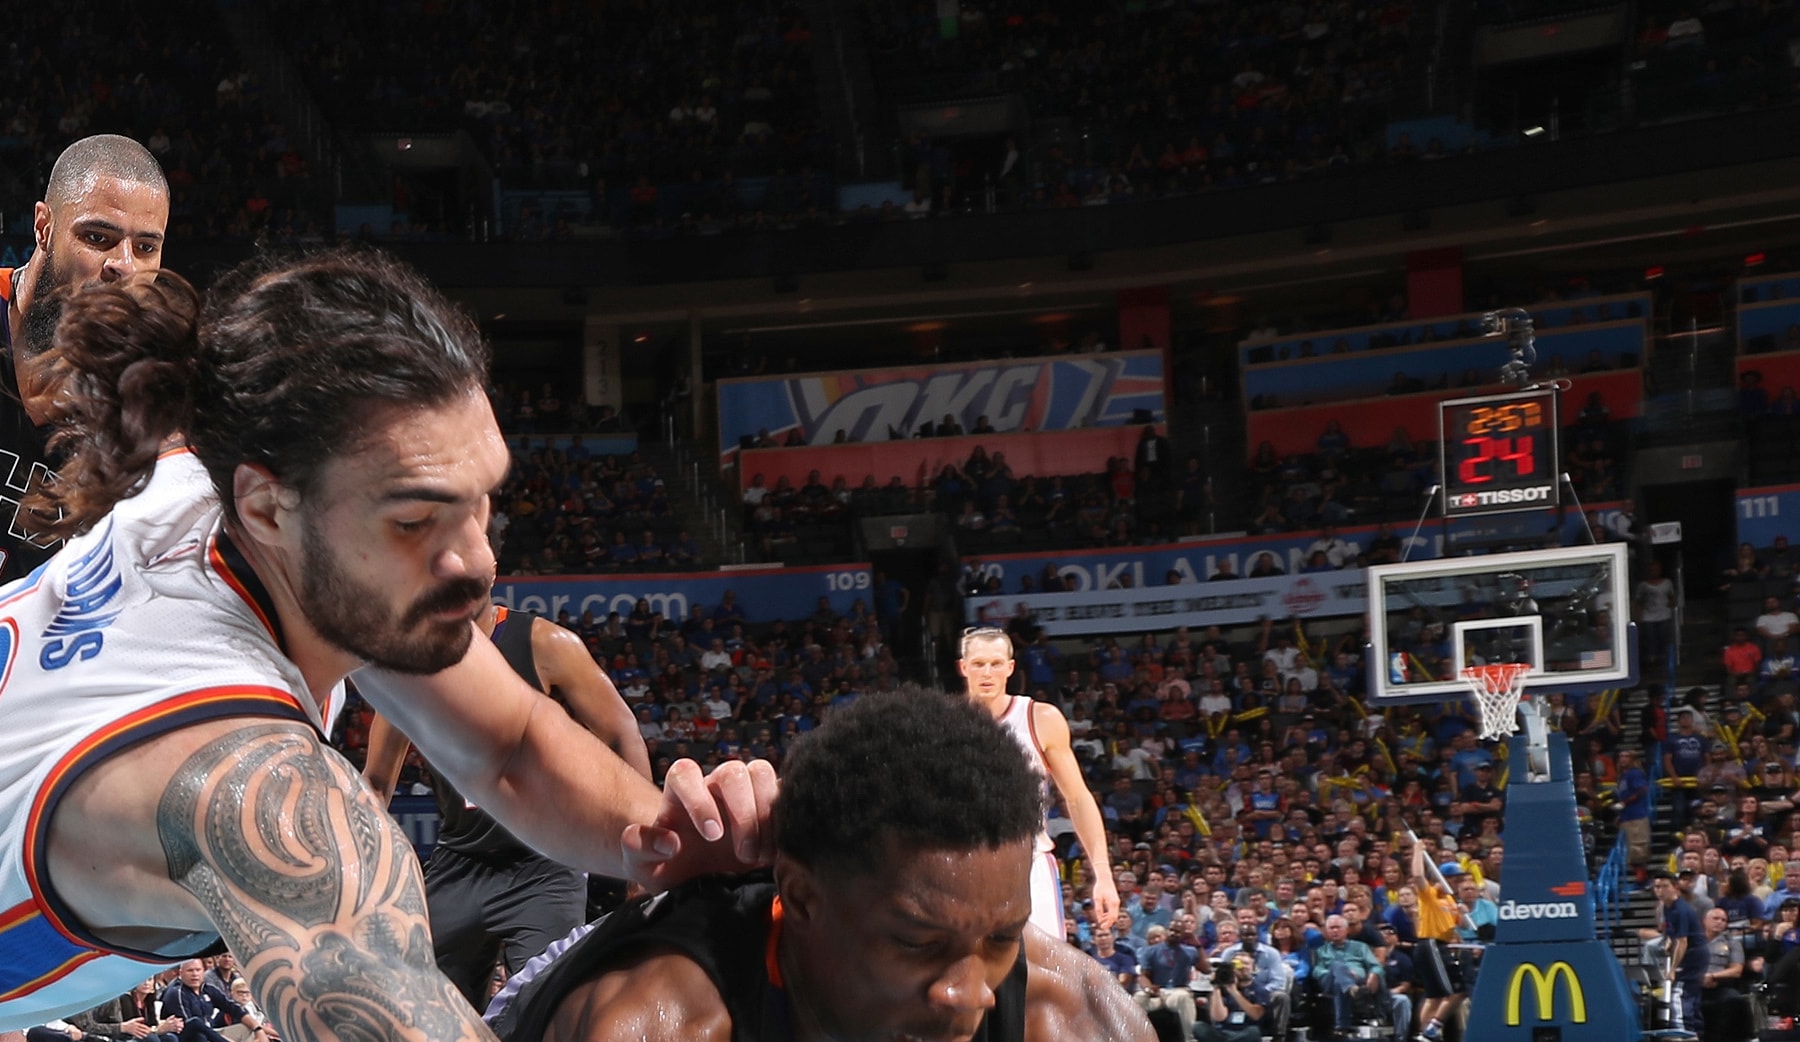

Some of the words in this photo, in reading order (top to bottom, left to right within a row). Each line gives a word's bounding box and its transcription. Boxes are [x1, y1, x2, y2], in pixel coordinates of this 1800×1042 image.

[806, 364, 1040, 446] OKC
[1457, 436, 1535, 484] 24
[1477, 485, 1551, 506] TISSOT
[39, 512, 124, 672] ADAMS
[826, 572, 871, 591] 109
[1059, 546, 1306, 592] OKLAHO
[1499, 899, 1579, 921] devon
